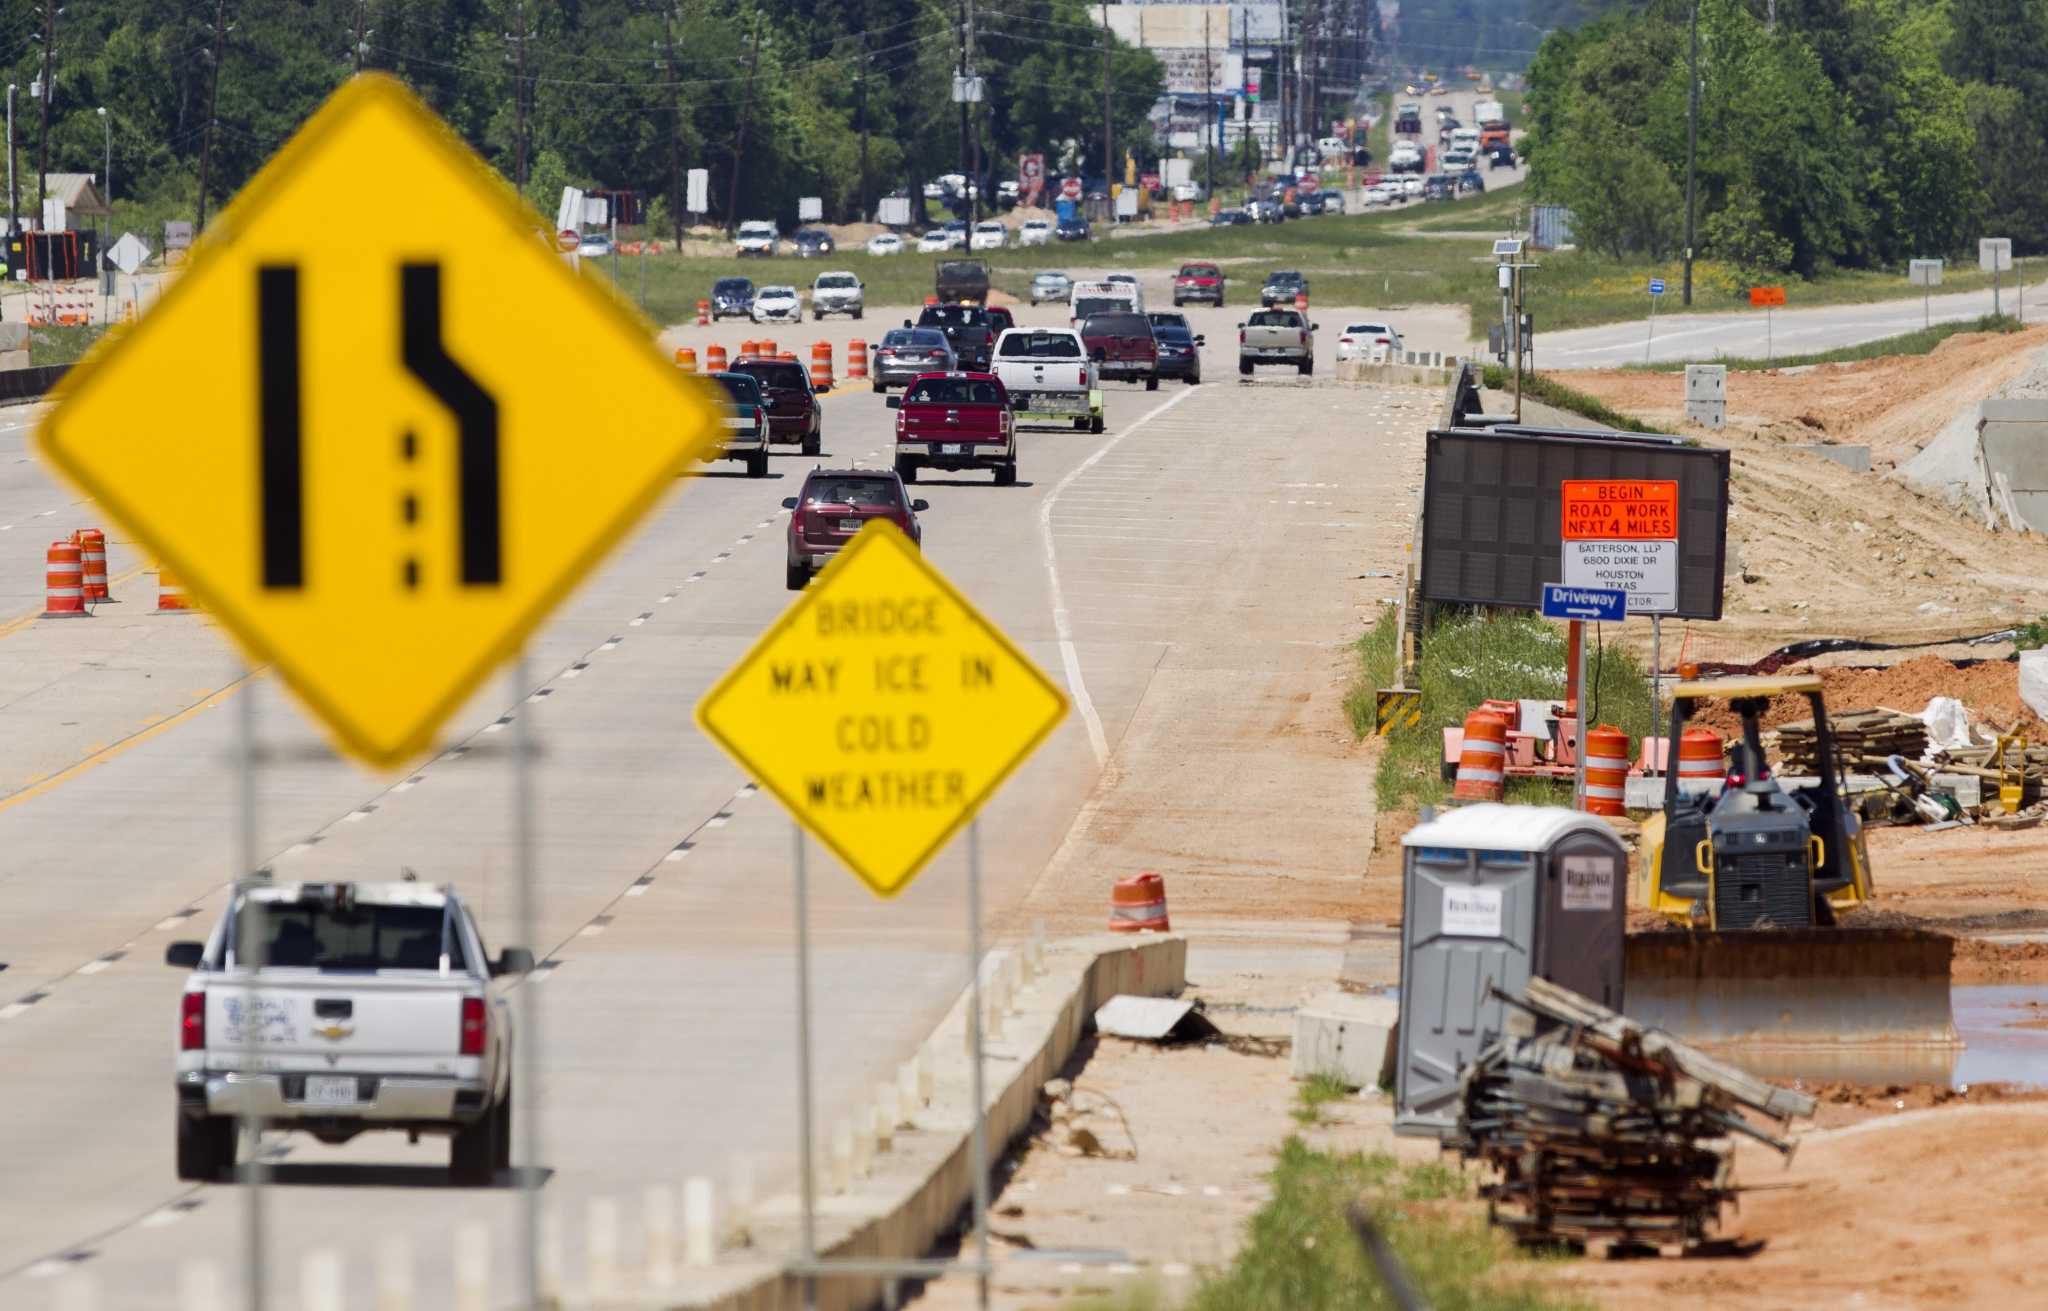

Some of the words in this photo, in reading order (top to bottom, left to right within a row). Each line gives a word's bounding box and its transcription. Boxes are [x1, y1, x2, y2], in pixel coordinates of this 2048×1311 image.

[1598, 486, 1643, 499] BEGIN
[1569, 504, 1611, 517] ROAD
[1626, 504, 1668, 517] WORK
[1568, 520, 1604, 533] NEXT
[1609, 519, 1620, 534] 4
[1627, 520, 1671, 533] MILES
[1643, 544, 1661, 553] LLP
[1614, 556, 1638, 565] DIXIE
[1643, 556, 1657, 565] DR
[1596, 570, 1644, 579] HOUSTON
[1604, 581, 1637, 590] TEXAS
[1552, 588, 1617, 609] Driveway
[816, 600, 944, 637] BRIDGE
[772, 660, 840, 692] MAY
[873, 655, 928, 692] ICE
[960, 656, 995, 691] IN
[836, 713, 930, 753] COLD
[805, 771, 963, 807] WEATHER
